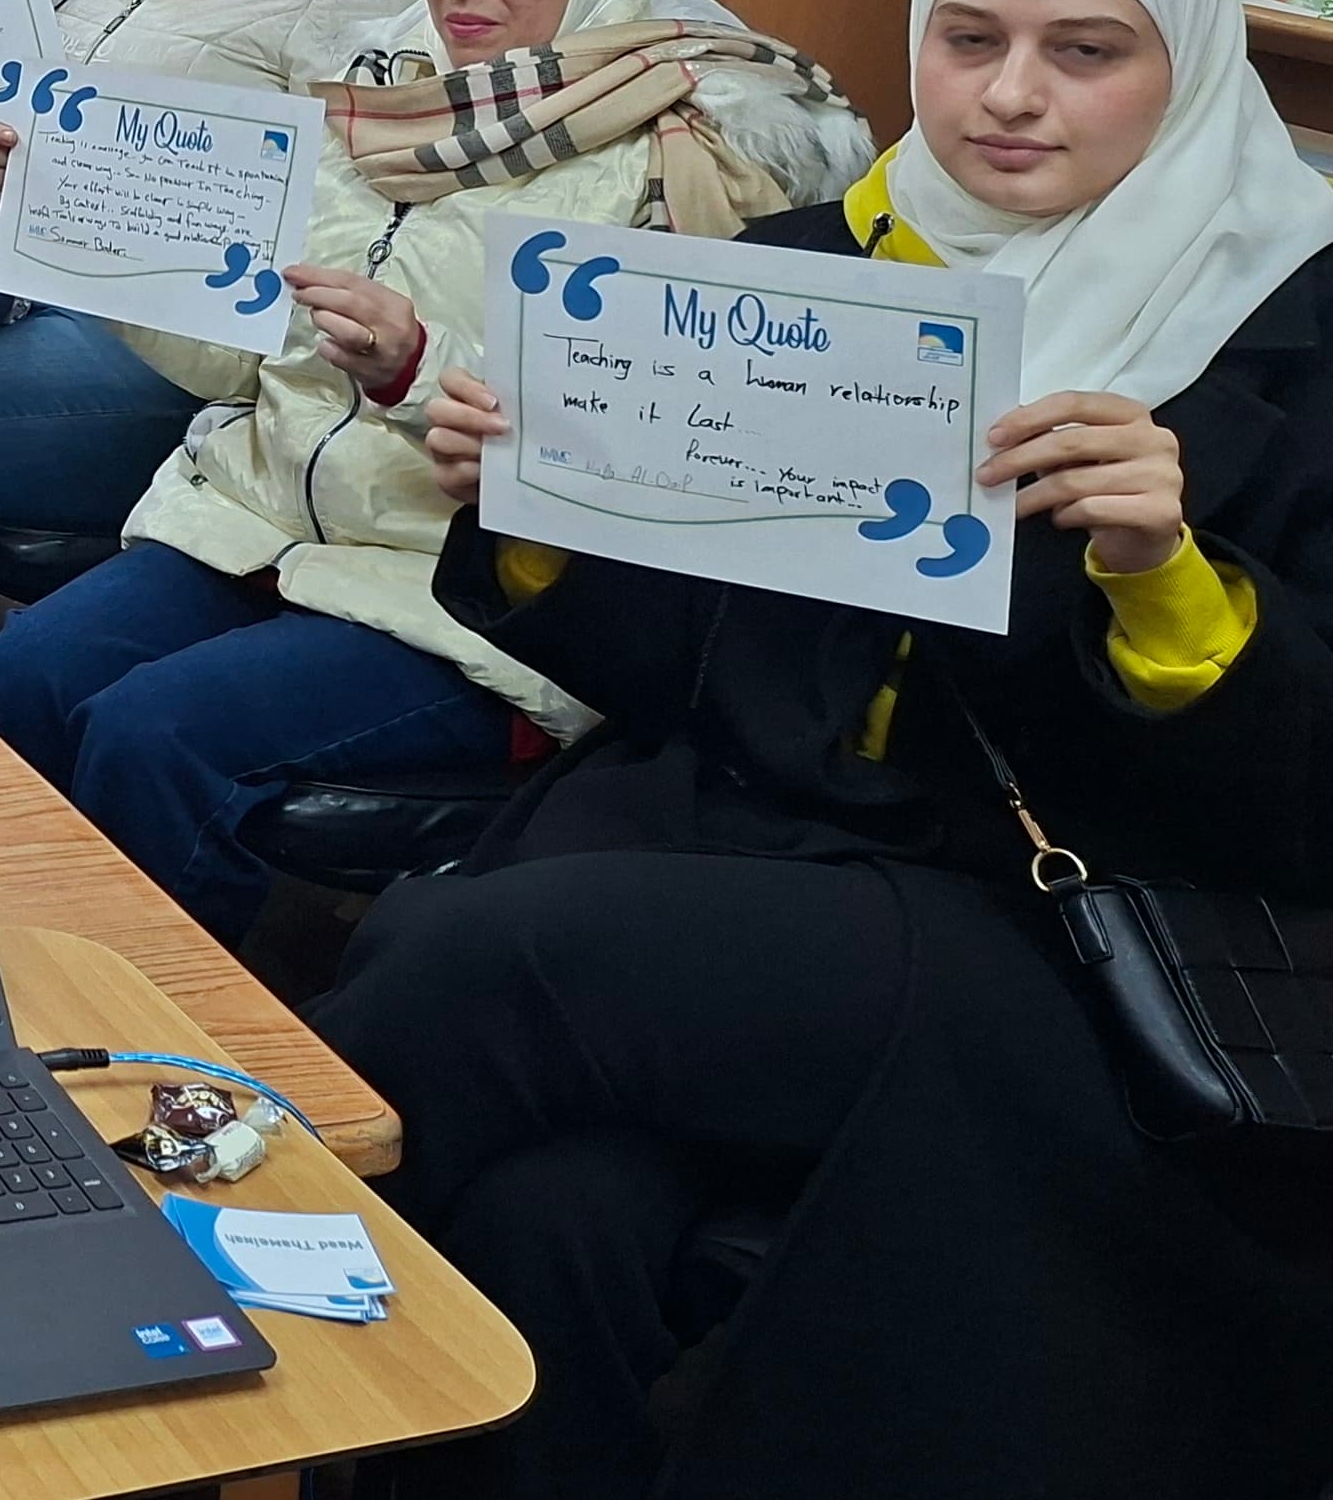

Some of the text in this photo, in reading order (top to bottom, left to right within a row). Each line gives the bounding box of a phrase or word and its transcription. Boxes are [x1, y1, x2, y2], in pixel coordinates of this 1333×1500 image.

[116, 104, 214, 156] My Quote
[663, 283, 832, 356] My Quote
[544, 332, 962, 425] Teaching is a human relationship
[562, 390, 663, 425] make it
[729, 476, 745, 490] is
[832, 472, 884, 496] impact
